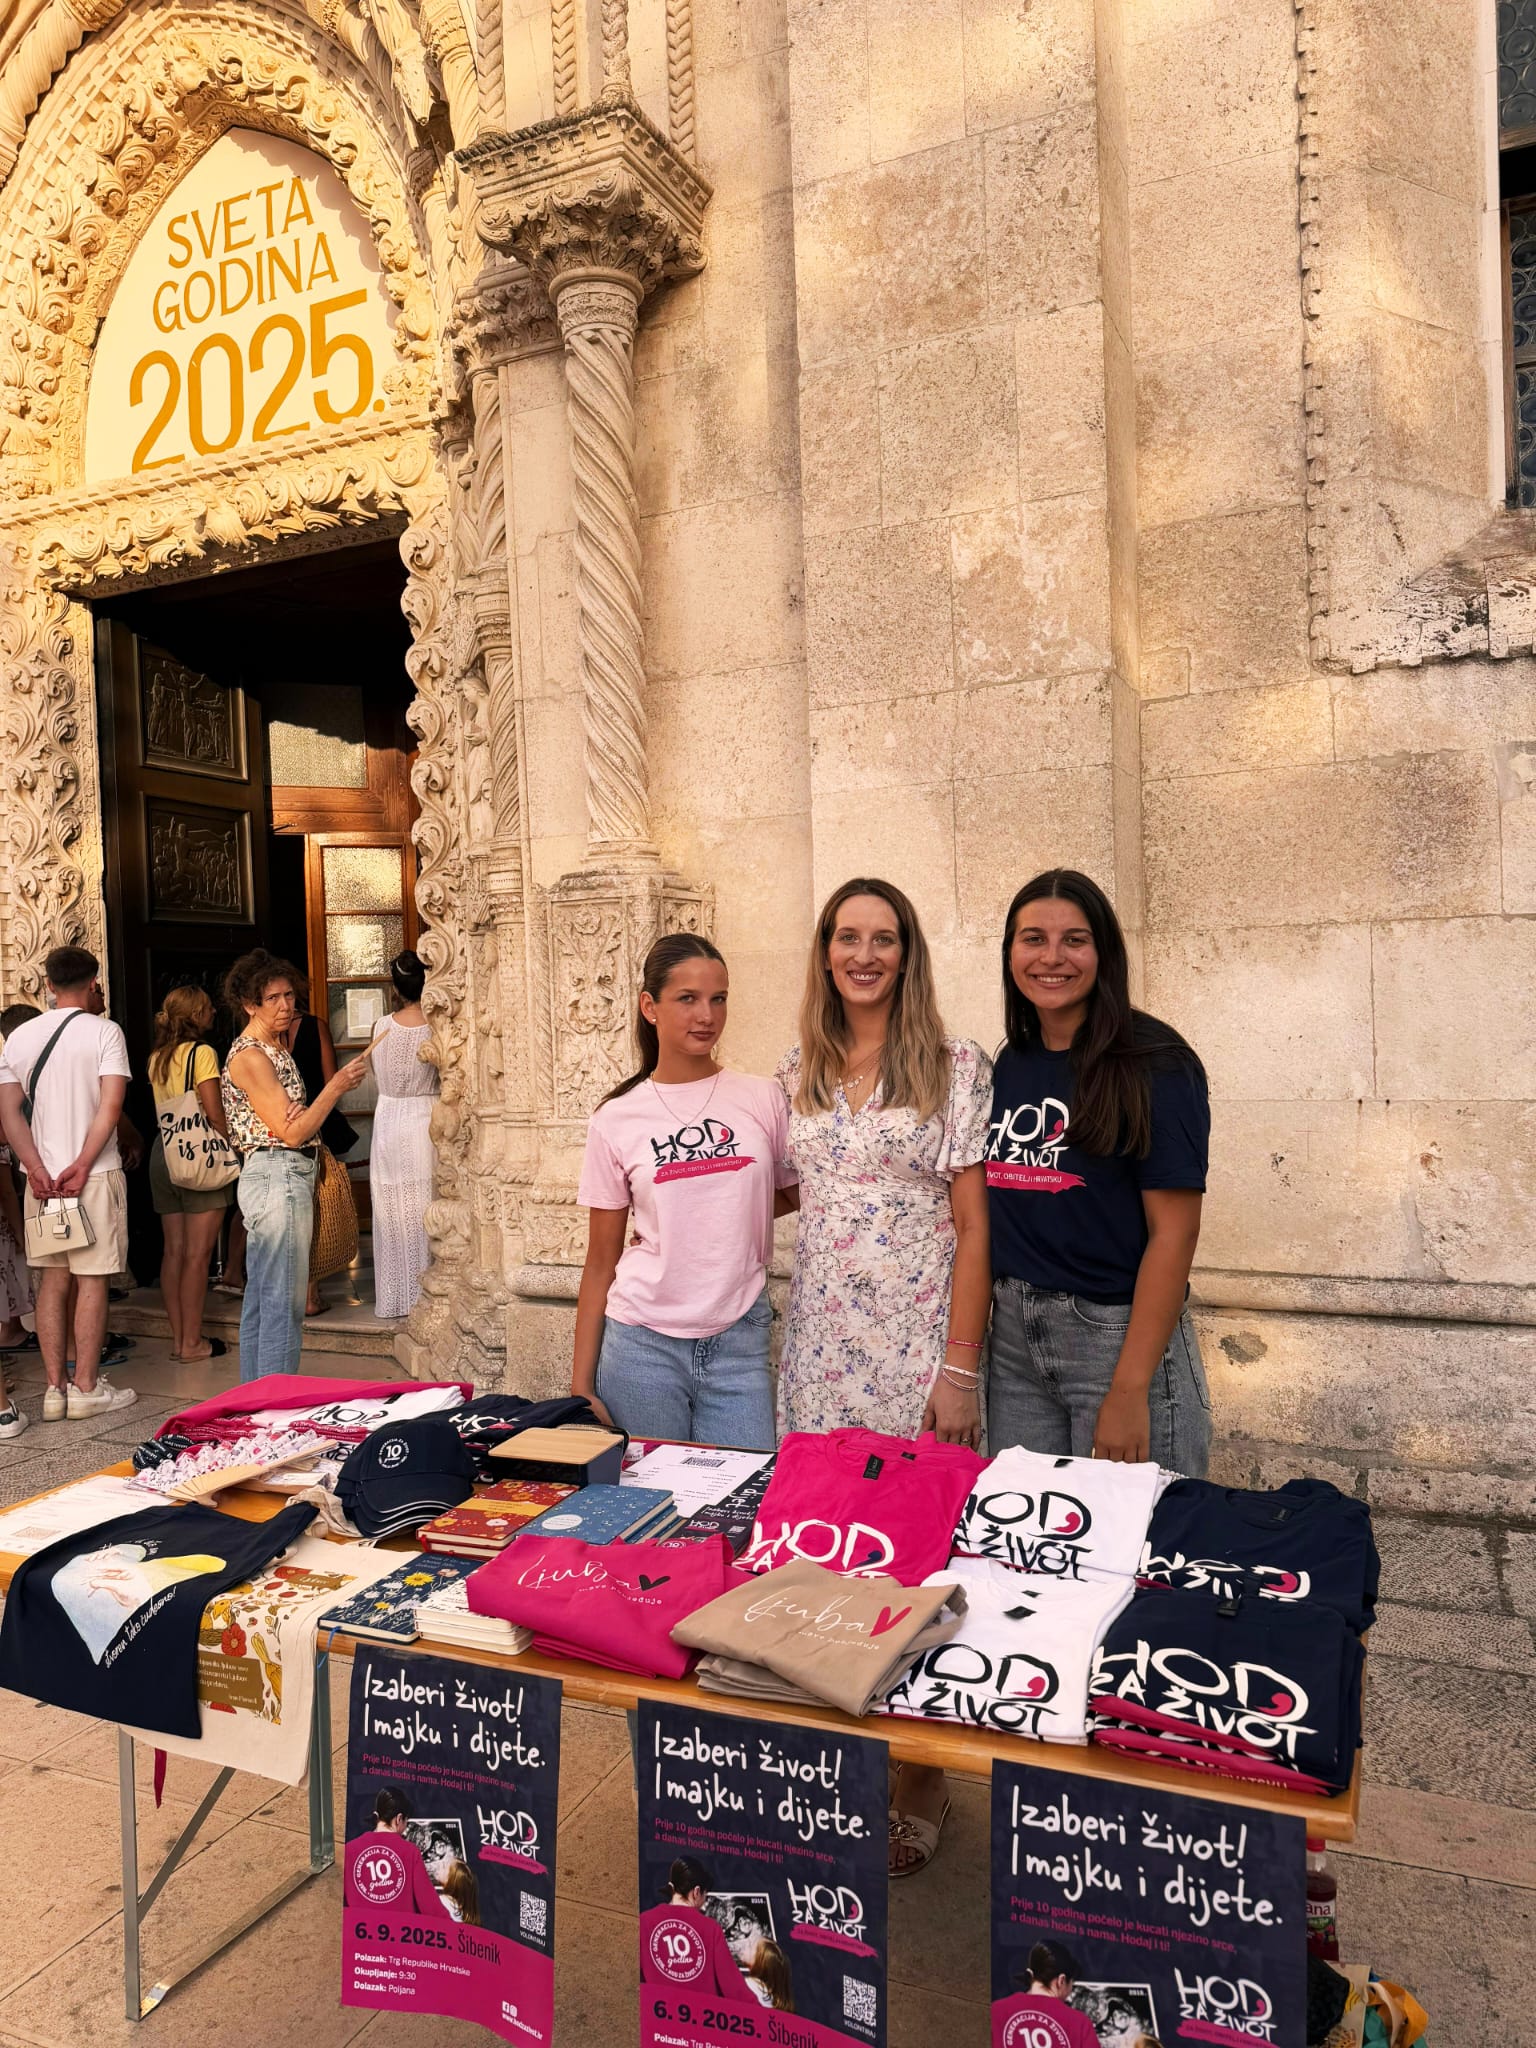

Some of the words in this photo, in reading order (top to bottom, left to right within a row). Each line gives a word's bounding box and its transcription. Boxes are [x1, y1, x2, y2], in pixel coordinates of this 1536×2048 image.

[167, 175, 314, 269] SVETA
[152, 232, 339, 334] GODINA
[129, 288, 386, 474] 2025.
[178, 1138, 200, 1160] is
[650, 1118, 735, 1158] HOD
[1004, 1142, 1070, 1170] ŽIVOT
[655, 1151, 681, 1167] ZA
[386, 1444, 402, 1458] 10
[748, 1519, 894, 1576] HOD
[364, 1663, 445, 1707] Izaberi
[455, 1678, 524, 1727] život!
[1092, 1639, 1309, 1723] HOD
[920, 1681, 1061, 1736] ŽIVOT
[1089, 1670, 1146, 1706] ZA
[1156, 1685, 1318, 1760] ŽIVOT
[364, 1703, 370, 1736] I
[374, 1710, 442, 1754] majku
[453, 1724, 459, 1748] i
[470, 1721, 546, 1771] dijete.
[381, 1755, 392, 1765] 10
[655, 1720, 748, 1770] Izaberi
[758, 1739, 843, 1795] život!
[655, 1762, 662, 1800] I
[667, 1772, 745, 1822] majku
[756, 1788, 764, 1816] i
[777, 1786, 871, 1842] dijete.
[477, 1804, 538, 1845] HOD
[655, 1817, 674, 1831] Prije
[675, 1821, 687, 1832] 10
[687, 1825, 716, 1839] godina
[688, 1837, 709, 1850] hoda
[1011, 1785, 1127, 1845] Izaberi
[1142, 1810, 1247, 1875] život!
[480, 1832, 499, 1846] ZA
[502, 1836, 541, 1861] ŽIVOT
[366, 1859, 392, 1881] 10
[1011, 1833, 1019, 1876] I
[1025, 1847, 1123, 1902] majku
[1138, 1866, 1147, 1897] i
[1164, 1863, 1283, 1927] dijete.
[787, 1877, 863, 1923] HOD
[1010, 1895, 1034, 1911] Prije
[1036, 1901, 1050, 1913] 10
[1051, 1906, 1086, 1921] godina
[1306, 1903, 1331, 1917] ana
[355, 1922, 373, 1940] 6.
[377, 1924, 396, 1942] 9.
[400, 1926, 453, 1951] 2025.
[457, 1927, 501, 1966] Šibenik
[792, 1907, 815, 1924] ZA
[819, 1913, 867, 1942] ŽIVOT
[1051, 1919, 1077, 1934] hoda
[1120, 1932, 1152, 1950] Hodaj
[354, 1952, 387, 1964] Polazak:
[388, 1955, 401, 1967] Trg
[402, 1957, 439, 1970] Republike
[662, 1934, 690, 1957] 10
[354, 1966, 398, 1980] Okupljanje:
[399, 1970, 417, 1980] 9:30
[354, 1981, 387, 1993] Dolazak:
[388, 1984, 416, 1995] Poljana
[1174, 1967, 1272, 2021] HOD
[653, 2000, 674, 2020] 6.
[677, 2004, 697, 2025] 9.
[702, 2008, 762, 2039] 2025.
[768, 2015, 820, 2048] Šibenik
[653, 2032, 689, 2048] Polazak:
[1018, 2027, 1052, 2048] 10
[1179, 2001, 1209, 2020] ZA
[1214, 2008, 1278, 2042] ŽIVOT
